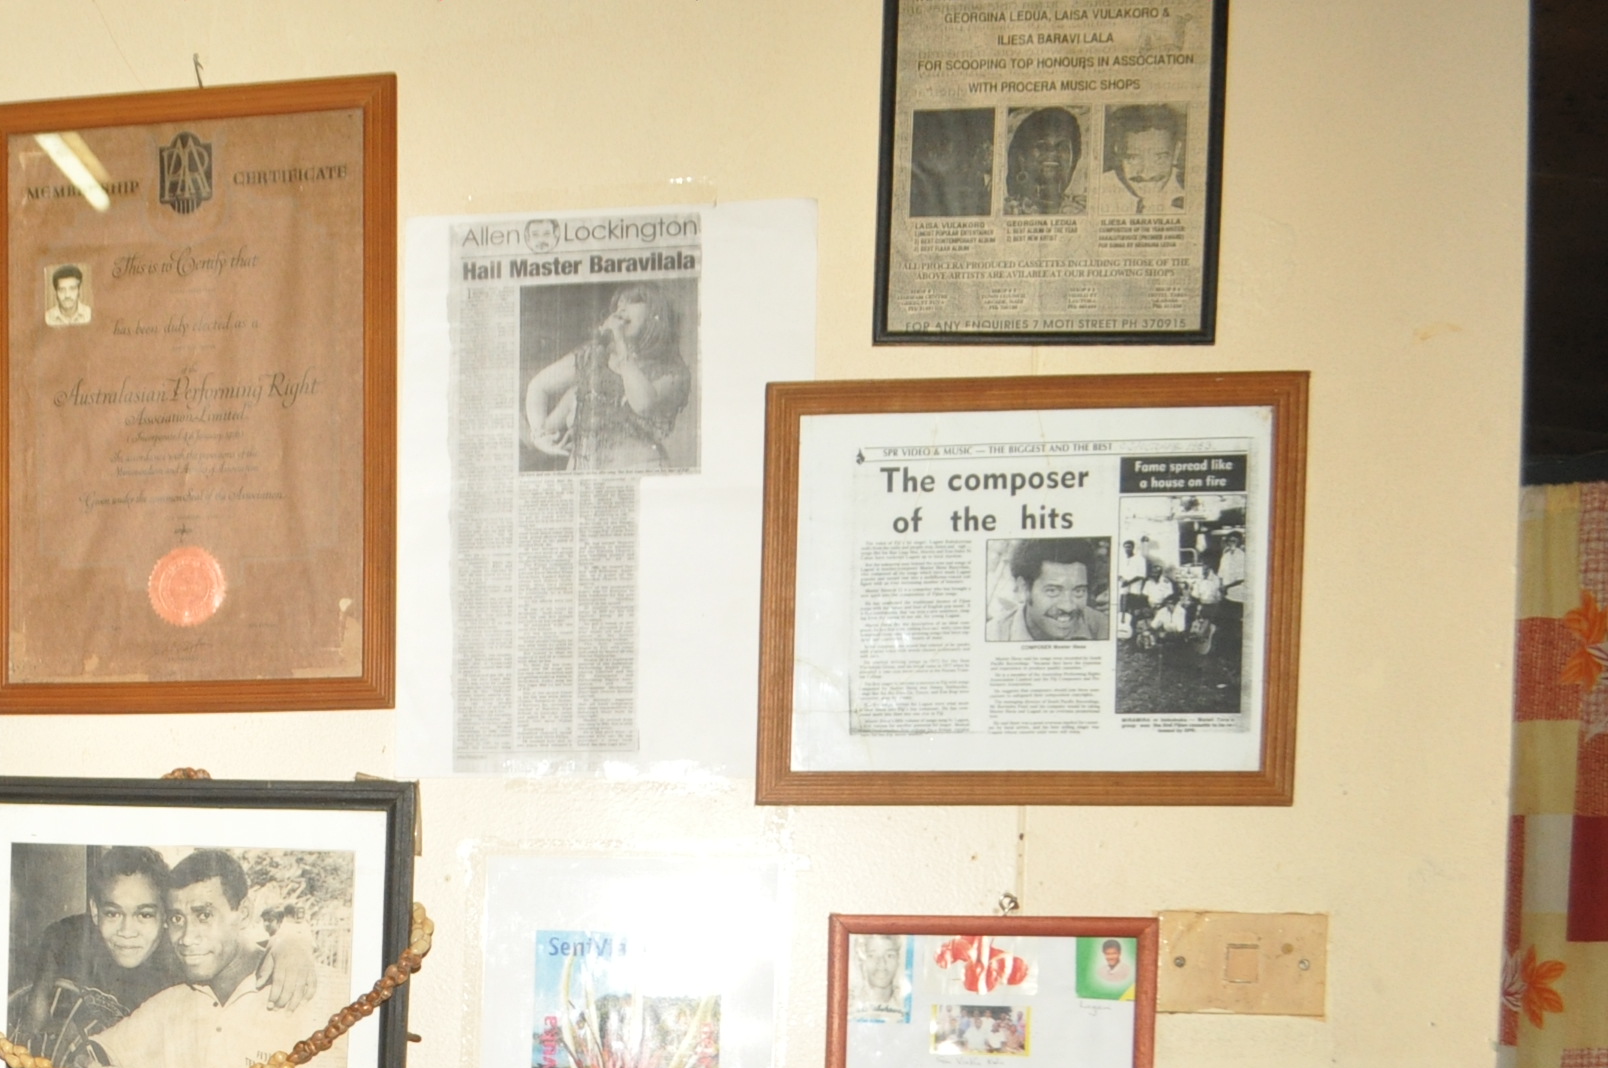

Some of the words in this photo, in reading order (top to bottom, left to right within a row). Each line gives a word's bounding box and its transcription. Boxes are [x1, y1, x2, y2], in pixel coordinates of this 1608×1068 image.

[944, 12, 1006, 25] GEORGINA
[1054, 9, 1088, 21] LAISA
[1092, 8, 1159, 20] VULAKORO
[1162, 8, 1170, 18] &
[997, 34, 1034, 46] ILIESA
[918, 60, 942, 72] FOR
[946, 58, 1006, 71] SCOOPING
[1010, 57, 1033, 69] TOP
[1037, 56, 1094, 69] HONOURS
[1097, 56, 1109, 67] IN
[1112, 54, 1194, 67] ASSOCIATION
[968, 81, 997, 94] WITH
[1000, 80, 1056, 92] PROCERA
[1060, 80, 1096, 91] MUSIC
[1100, 78, 1140, 90] SHOPS
[233, 165, 348, 185] CERTIFICATE
[462, 226, 520, 247] Allen
[564, 217, 698, 243] Lockington
[509, 255, 582, 279] Master
[589, 250, 695, 275] Baravilala
[906, 322, 930, 332] FOR
[936, 321, 960, 331] ANY
[1032, 320, 1039, 329] 7
[1042, 319, 1074, 329] MOTI
[1078, 319, 1118, 329] STREET
[1122, 319, 1137, 328] PH
[1142, 318, 1186, 328] 370915
[165, 373, 263, 410] Performing
[263, 366, 322, 408] Right
[1134, 460, 1166, 473] Fame
[1169, 459, 1207, 474] spread
[1210, 458, 1233, 471] like
[879, 466, 935, 493] The
[947, 469, 1090, 496] composer
[1139, 479, 1147, 489] a
[1150, 476, 1188, 489] house
[1207, 475, 1227, 487] fire
[892, 506, 923, 533] of
[950, 506, 997, 532] the
[1021, 504, 1074, 530] hits
